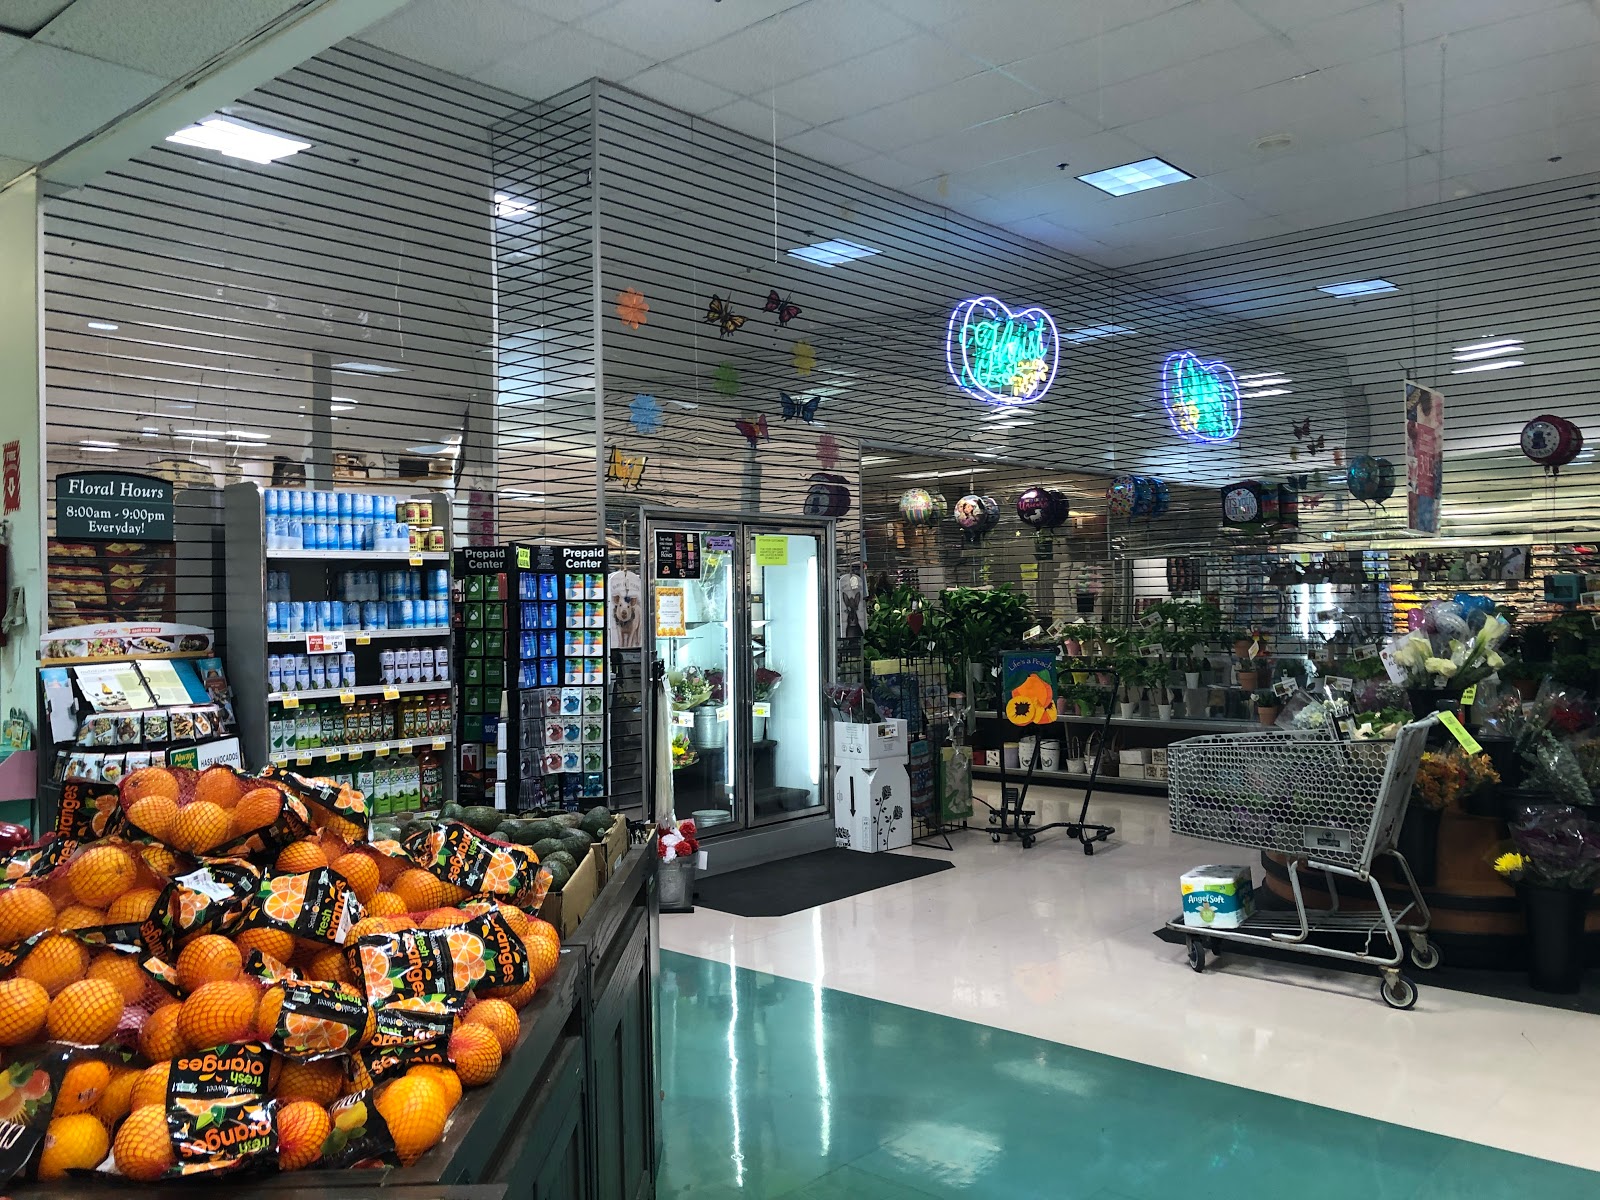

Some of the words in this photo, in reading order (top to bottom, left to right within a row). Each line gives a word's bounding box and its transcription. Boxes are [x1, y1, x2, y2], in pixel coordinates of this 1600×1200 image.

[68, 479, 114, 496] Floral
[120, 482, 164, 499] Hours
[66, 505, 111, 519] 8:00am
[122, 508, 165, 523] 9:00pm
[88, 520, 145, 535] Everyday!
[465, 549, 506, 560] Prepaid
[563, 548, 604, 559] Prepaid
[468, 559, 504, 569] Center
[565, 559, 602, 569] Center
[1032, 657, 1052, 670] Peach
[174, 752, 195, 763] Always
[200, 758, 213, 767] HASS
[214, 752, 239, 765] AVOCADOS
[424, 768, 436, 776] Aloe
[447, 831, 473, 882] oranges
[1188, 894, 1209, 904] Angel
[1209, 894, 1225, 904] Soft
[315, 908, 332, 936] fresh
[334, 992, 363, 1007] fresh
[178, 1054, 264, 1076] oranges
[230, 1071, 262, 1087] fresh
[180, 1120, 271, 1158] oranges
[238, 1136, 270, 1154] fresh
